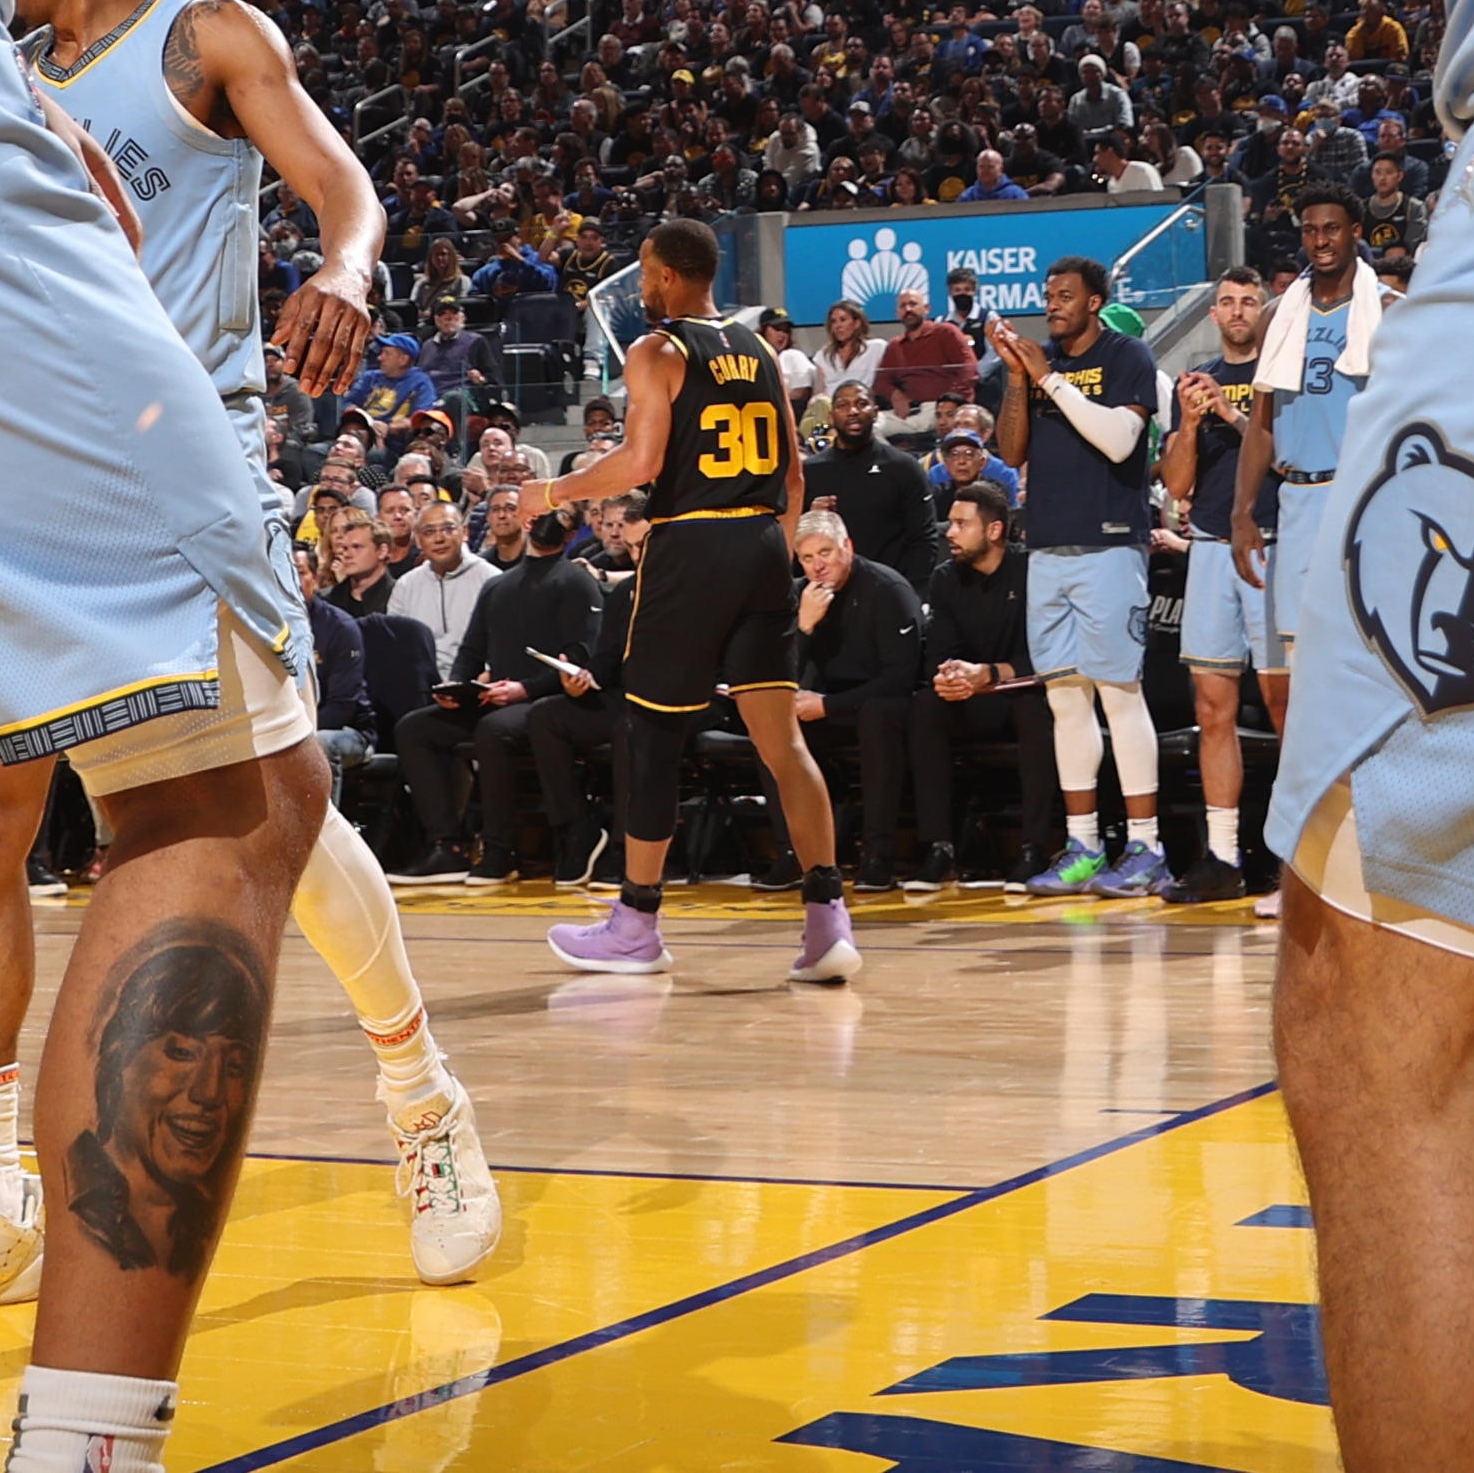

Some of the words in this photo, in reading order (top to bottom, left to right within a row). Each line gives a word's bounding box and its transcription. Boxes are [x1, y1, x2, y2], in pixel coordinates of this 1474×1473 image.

[947, 246, 1037, 276] KAISER
[708, 354, 759, 385] CURRY
[698, 401, 779, 479] 30
